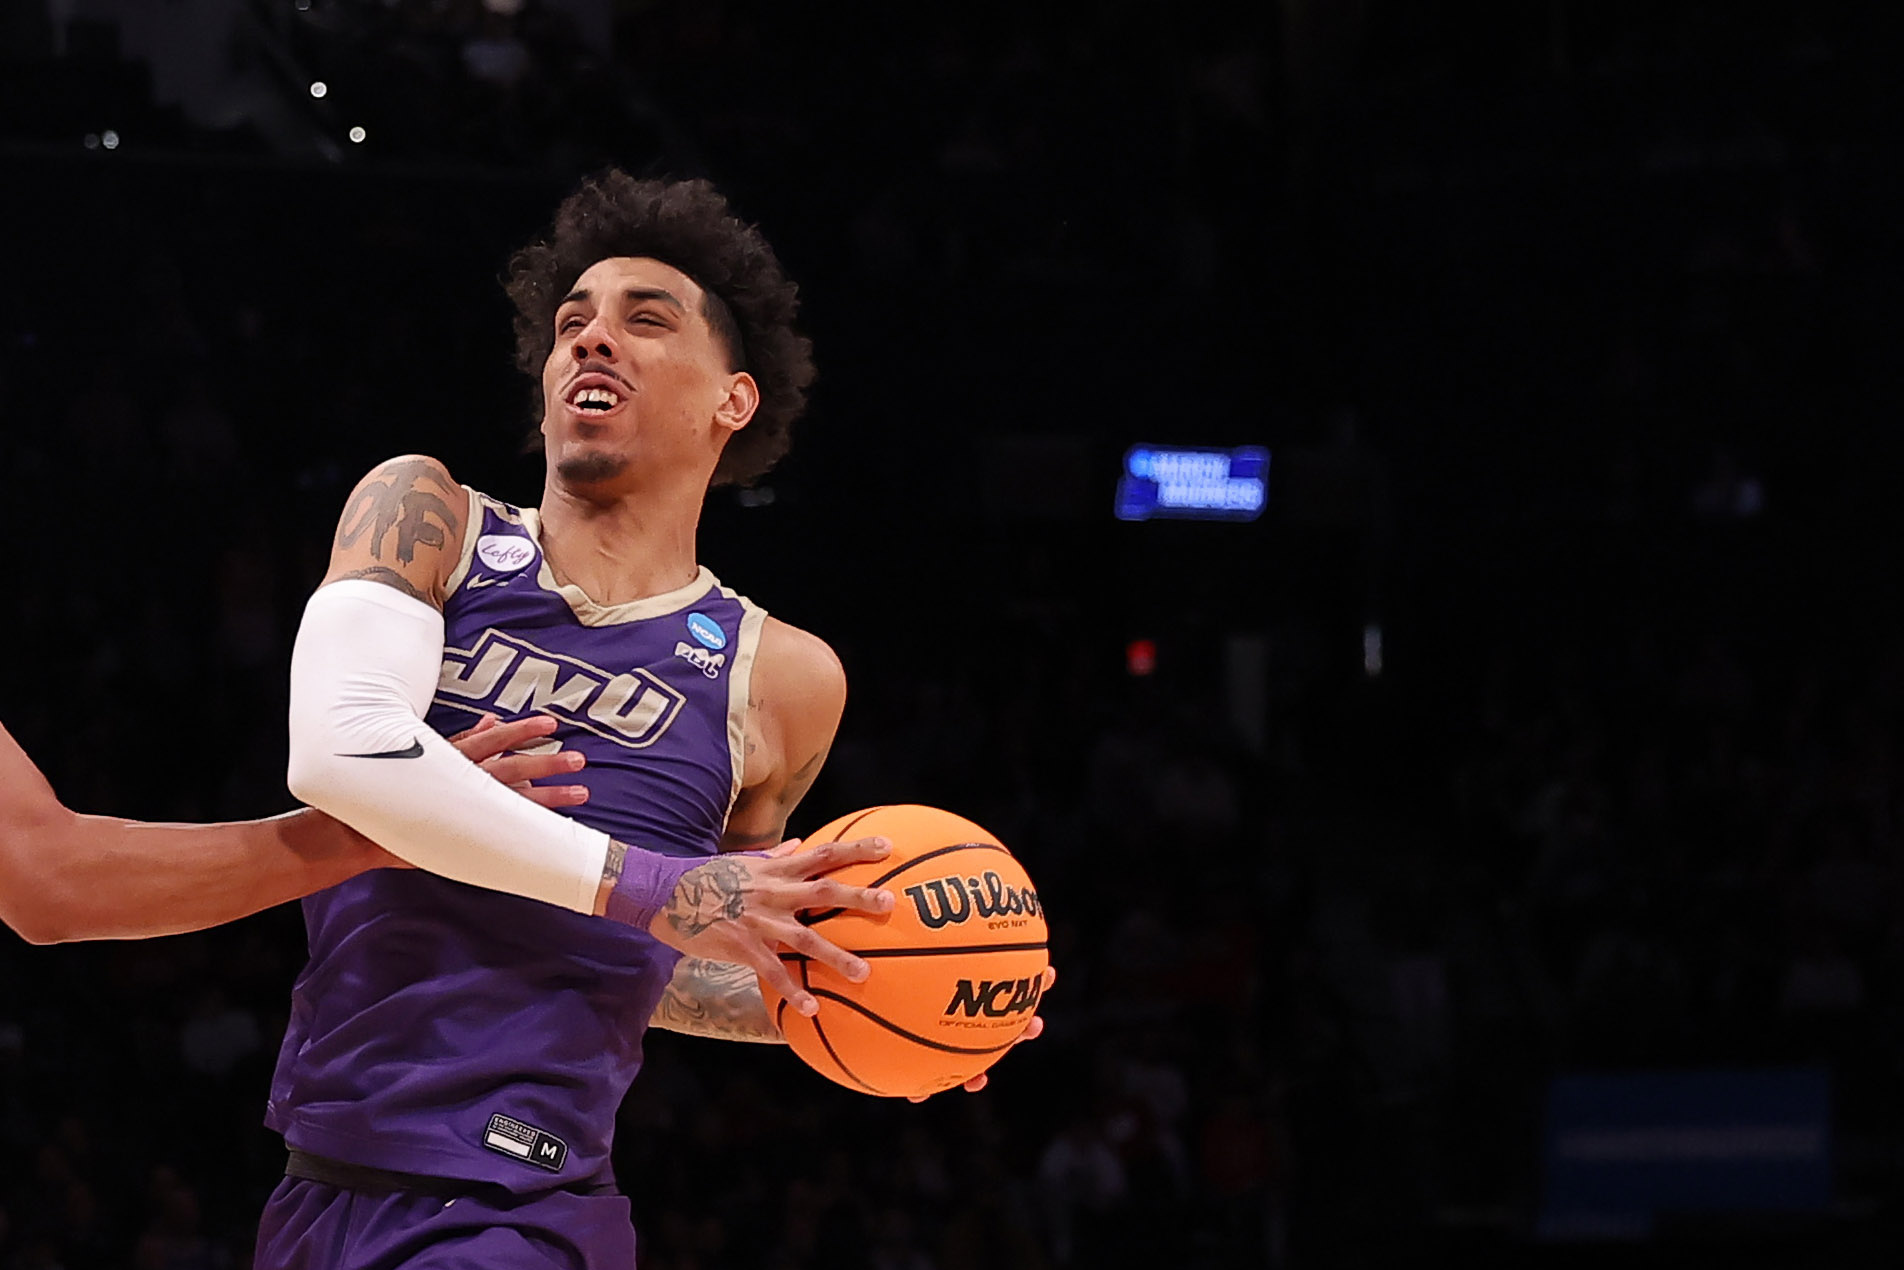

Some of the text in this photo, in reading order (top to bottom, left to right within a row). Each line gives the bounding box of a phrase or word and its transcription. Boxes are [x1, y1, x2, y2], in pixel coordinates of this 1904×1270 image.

[690, 621, 725, 648] NCAA
[437, 642, 671, 739] JMU
[944, 973, 1043, 1017] NCAA
[540, 1142, 558, 1160] M
